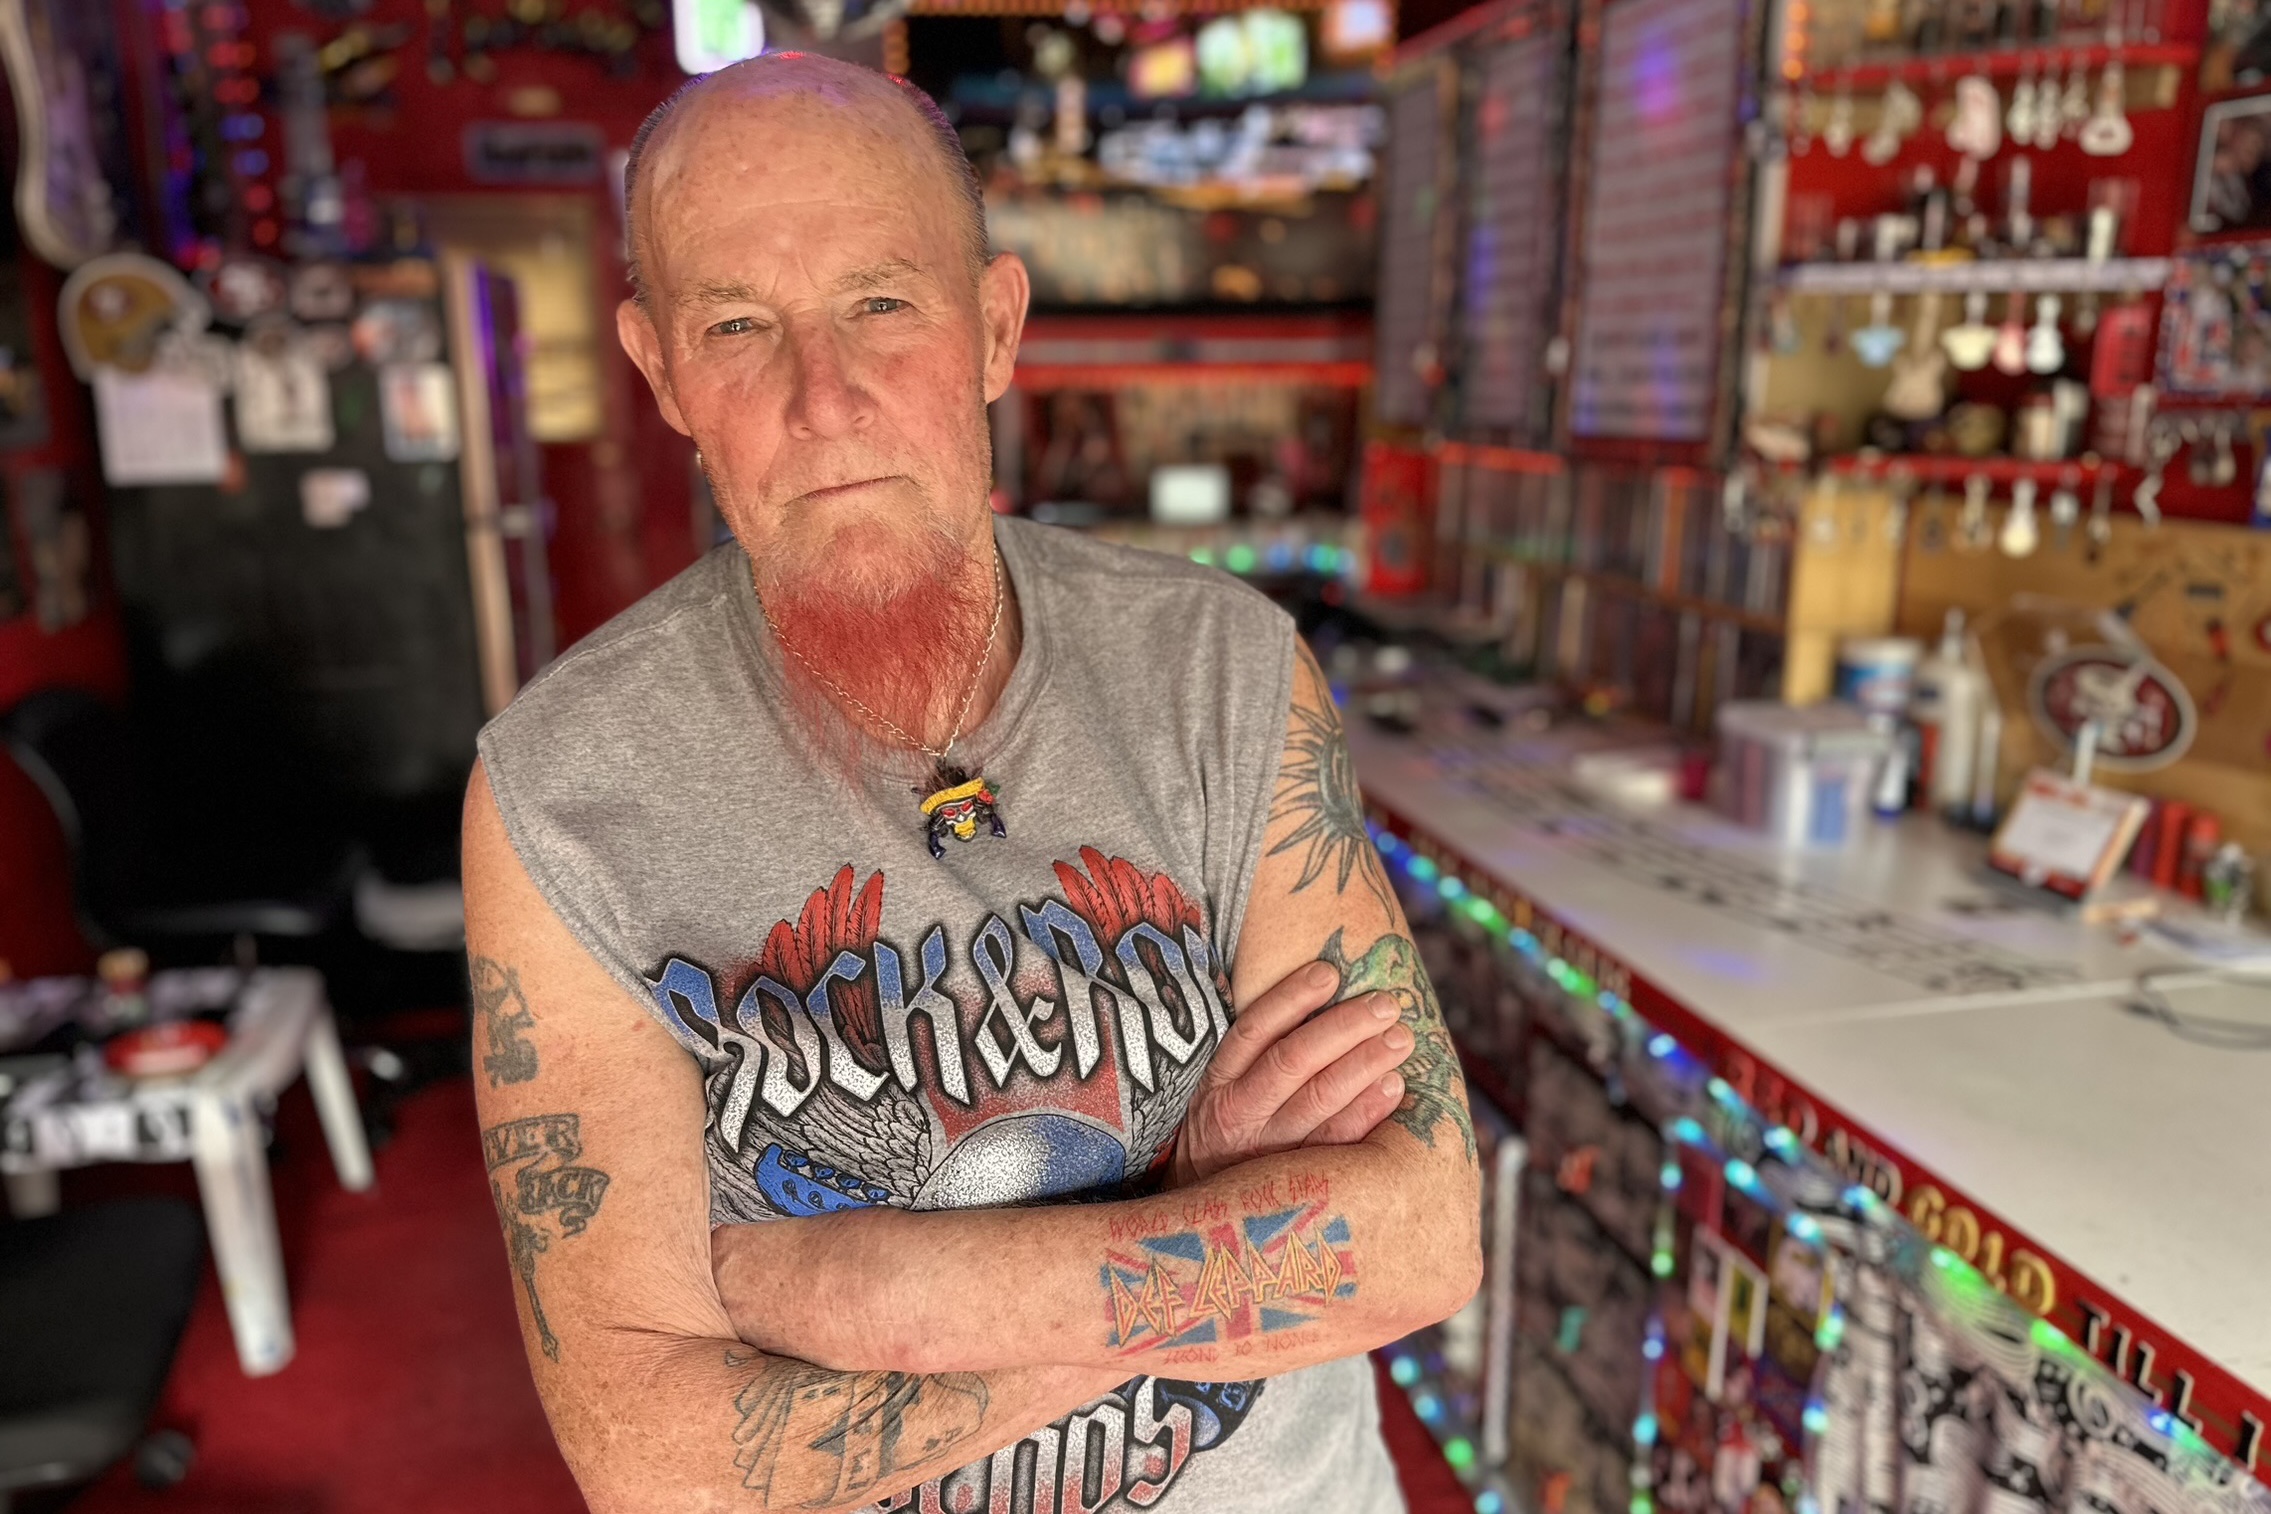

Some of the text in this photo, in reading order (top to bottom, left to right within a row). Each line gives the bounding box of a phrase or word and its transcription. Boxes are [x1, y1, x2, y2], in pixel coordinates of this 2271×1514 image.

[647, 899, 1234, 1154] ROCK & ROL
[1105, 1225, 1343, 1349] DEF LEPPARD
[1182, 1194, 1228, 1226] CLASS
[1907, 1183, 2057, 1317] GOLD
[2077, 1299, 2202, 1438] TILL
